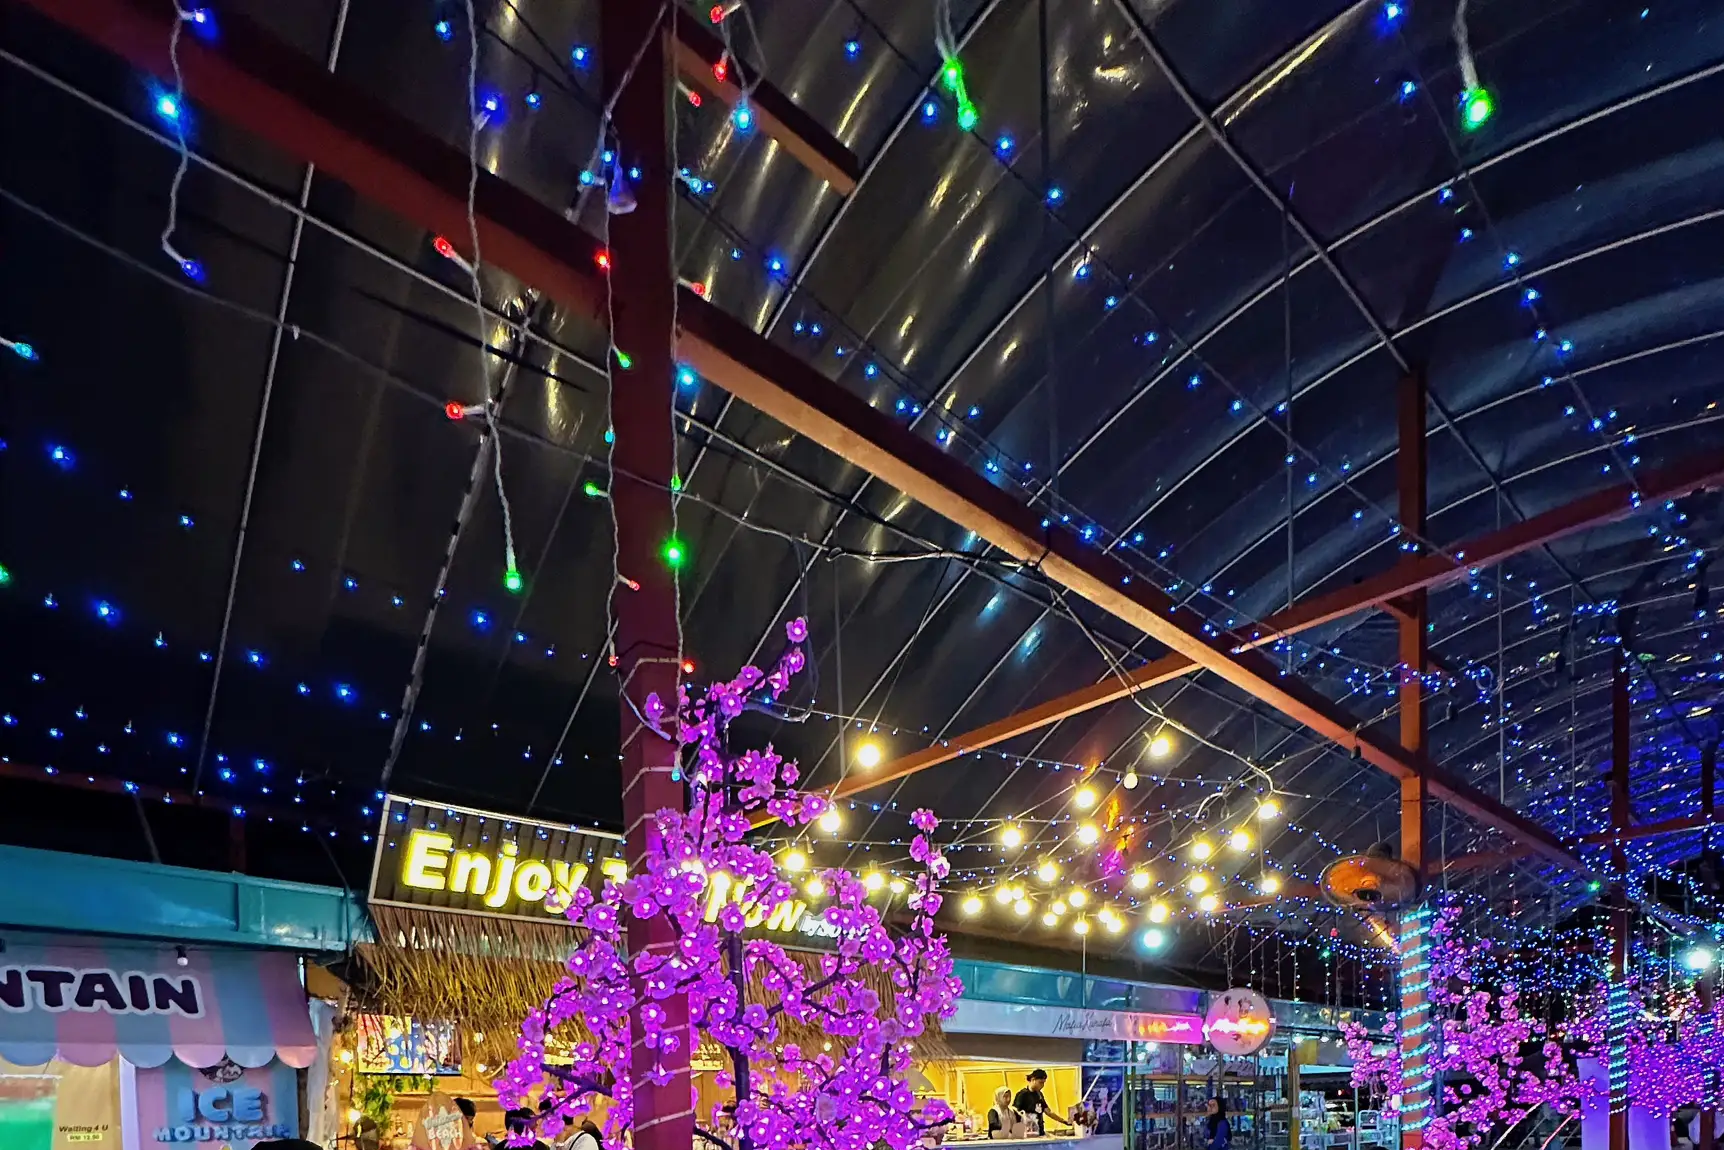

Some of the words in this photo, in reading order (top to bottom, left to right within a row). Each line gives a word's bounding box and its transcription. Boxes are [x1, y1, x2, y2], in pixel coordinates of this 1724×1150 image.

[402, 828, 588, 914] Enjoy
[178, 1087, 263, 1122] ICE
[59, 1125, 92, 1133] Waiting
